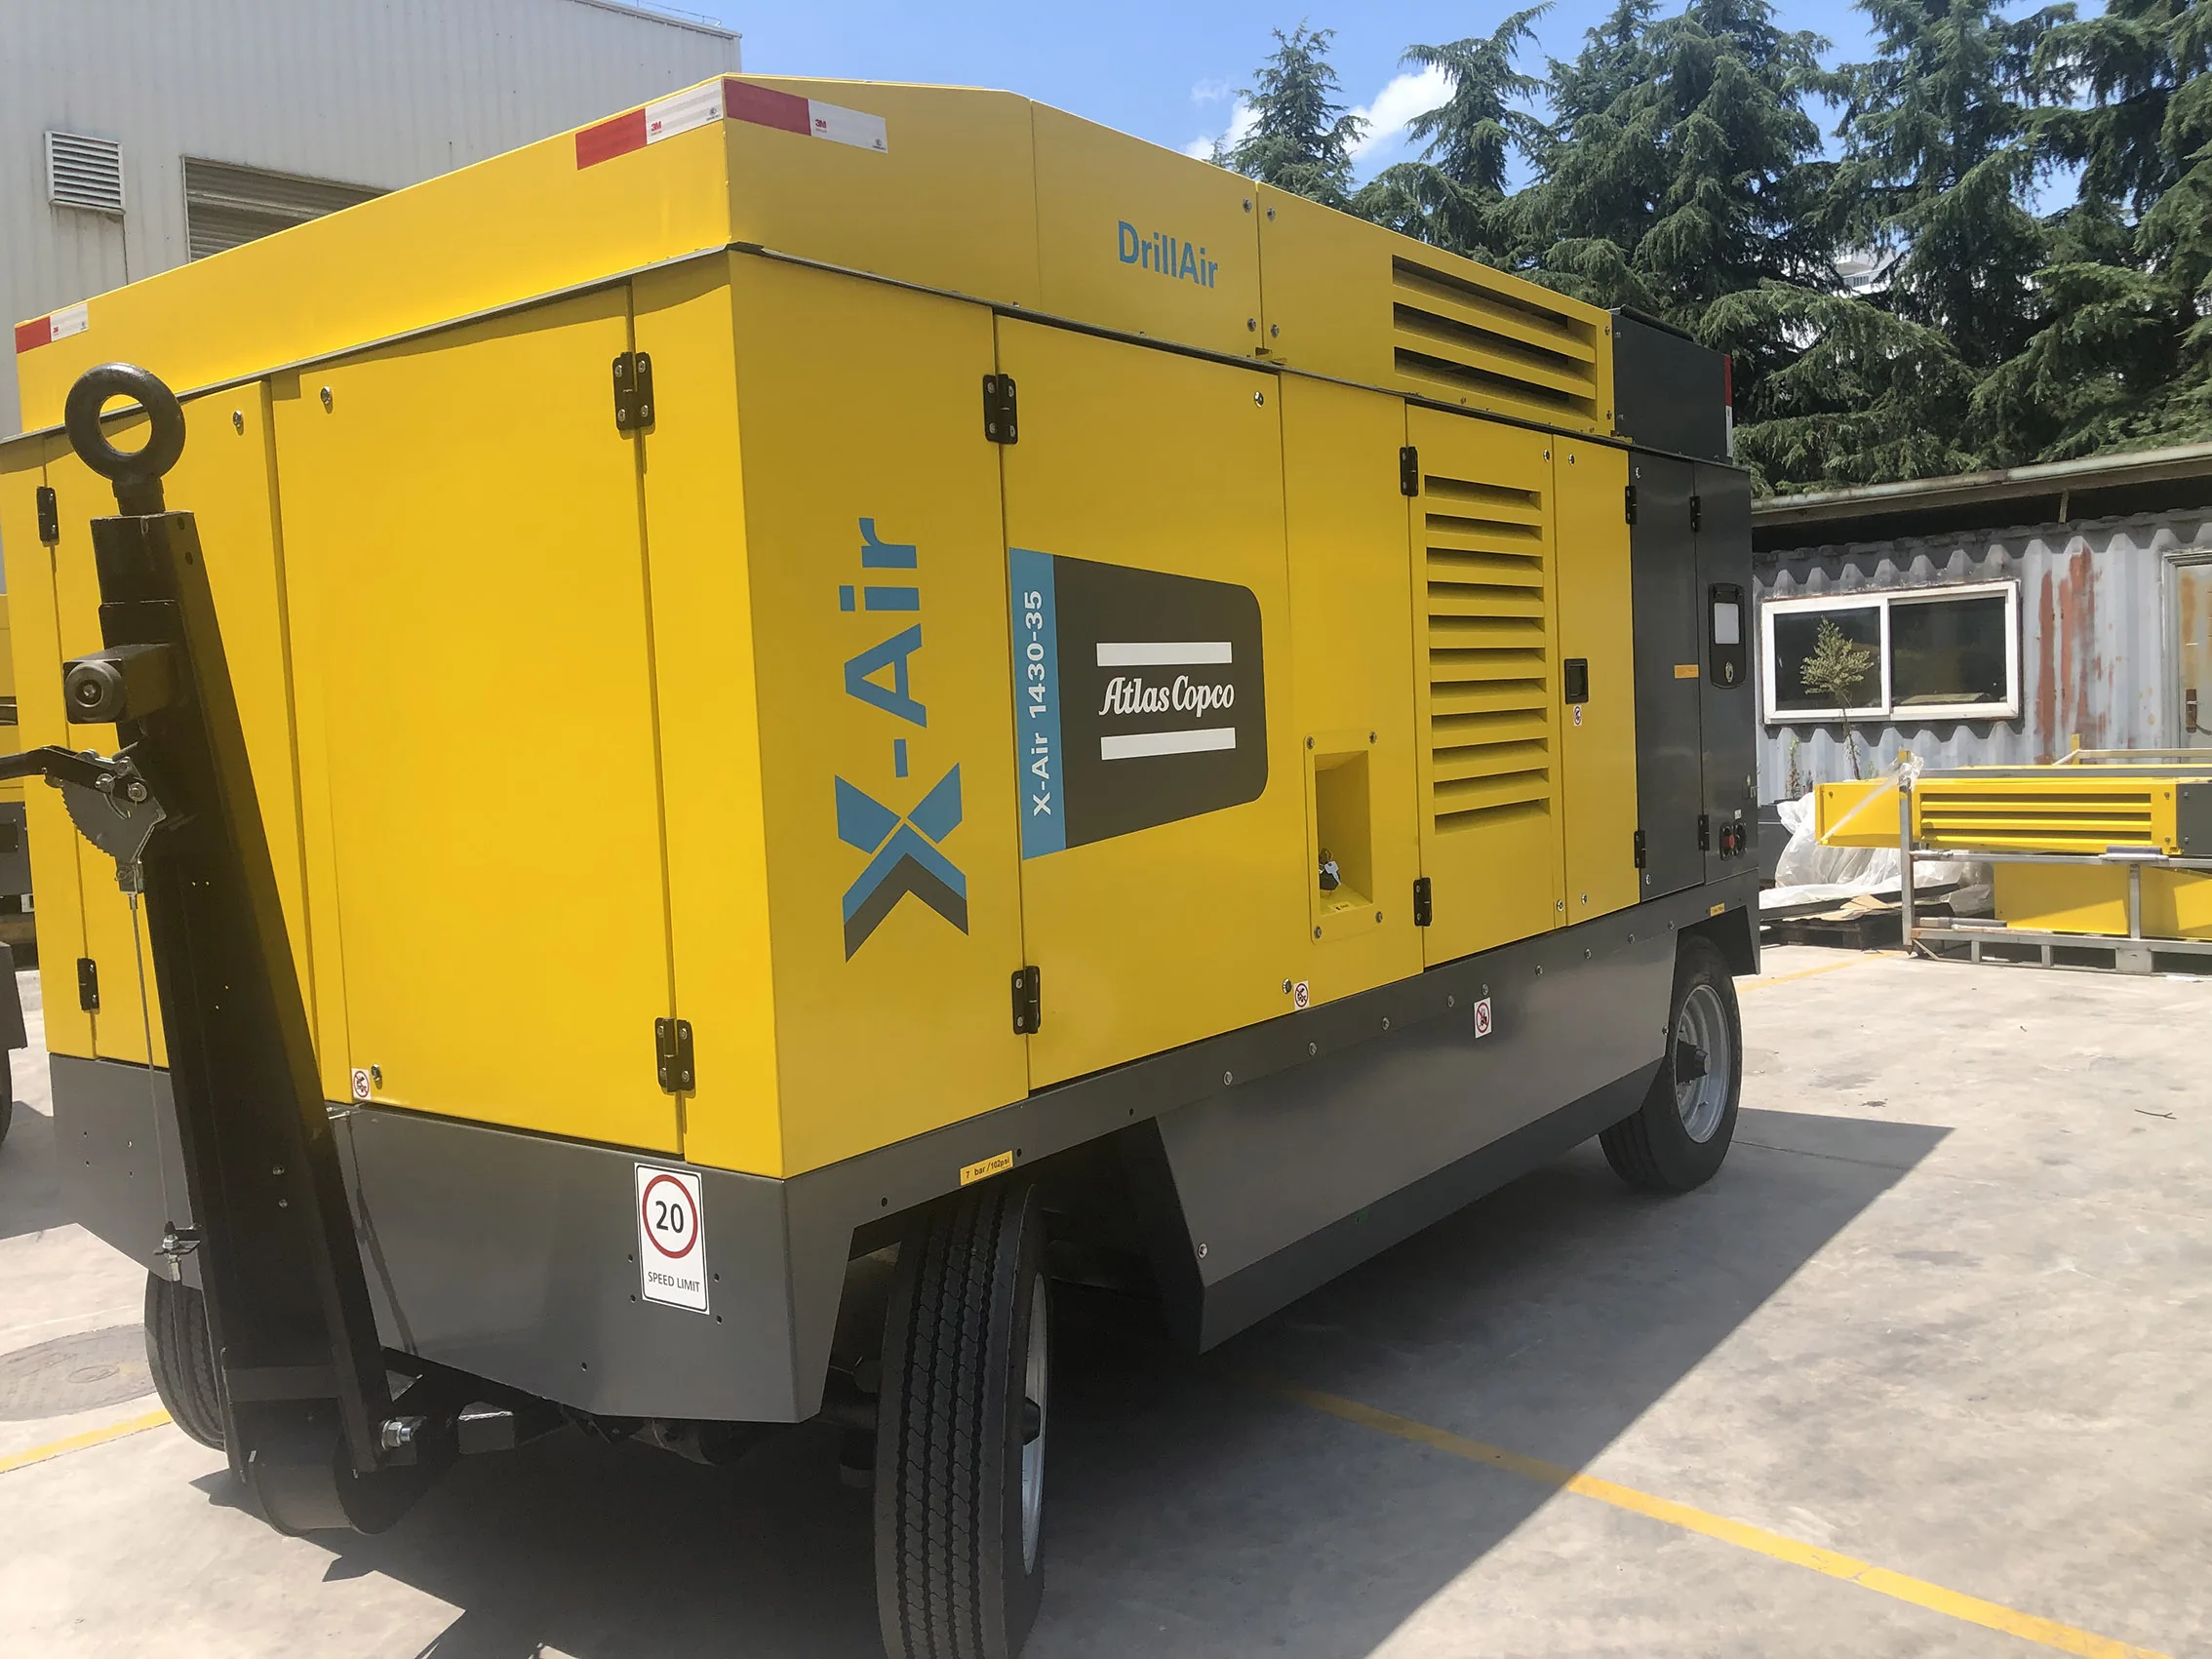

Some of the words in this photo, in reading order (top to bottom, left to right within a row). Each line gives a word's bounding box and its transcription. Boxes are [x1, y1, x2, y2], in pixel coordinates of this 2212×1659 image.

[651, 121, 662, 132] 3M
[815, 119, 827, 129] 3M
[1119, 220, 1218, 289] DrillAir
[1024, 591, 1047, 719] 1430-35
[1098, 677, 1170, 715] Atlas
[1172, 675, 1235, 718] Copco
[835, 518, 968, 963] X-Air
[1031, 732, 1051, 816] X-Air
[655, 1201, 684, 1234] 20
[648, 1271, 675, 1287] SPEED
[677, 1277, 700, 1293] LIMIT
